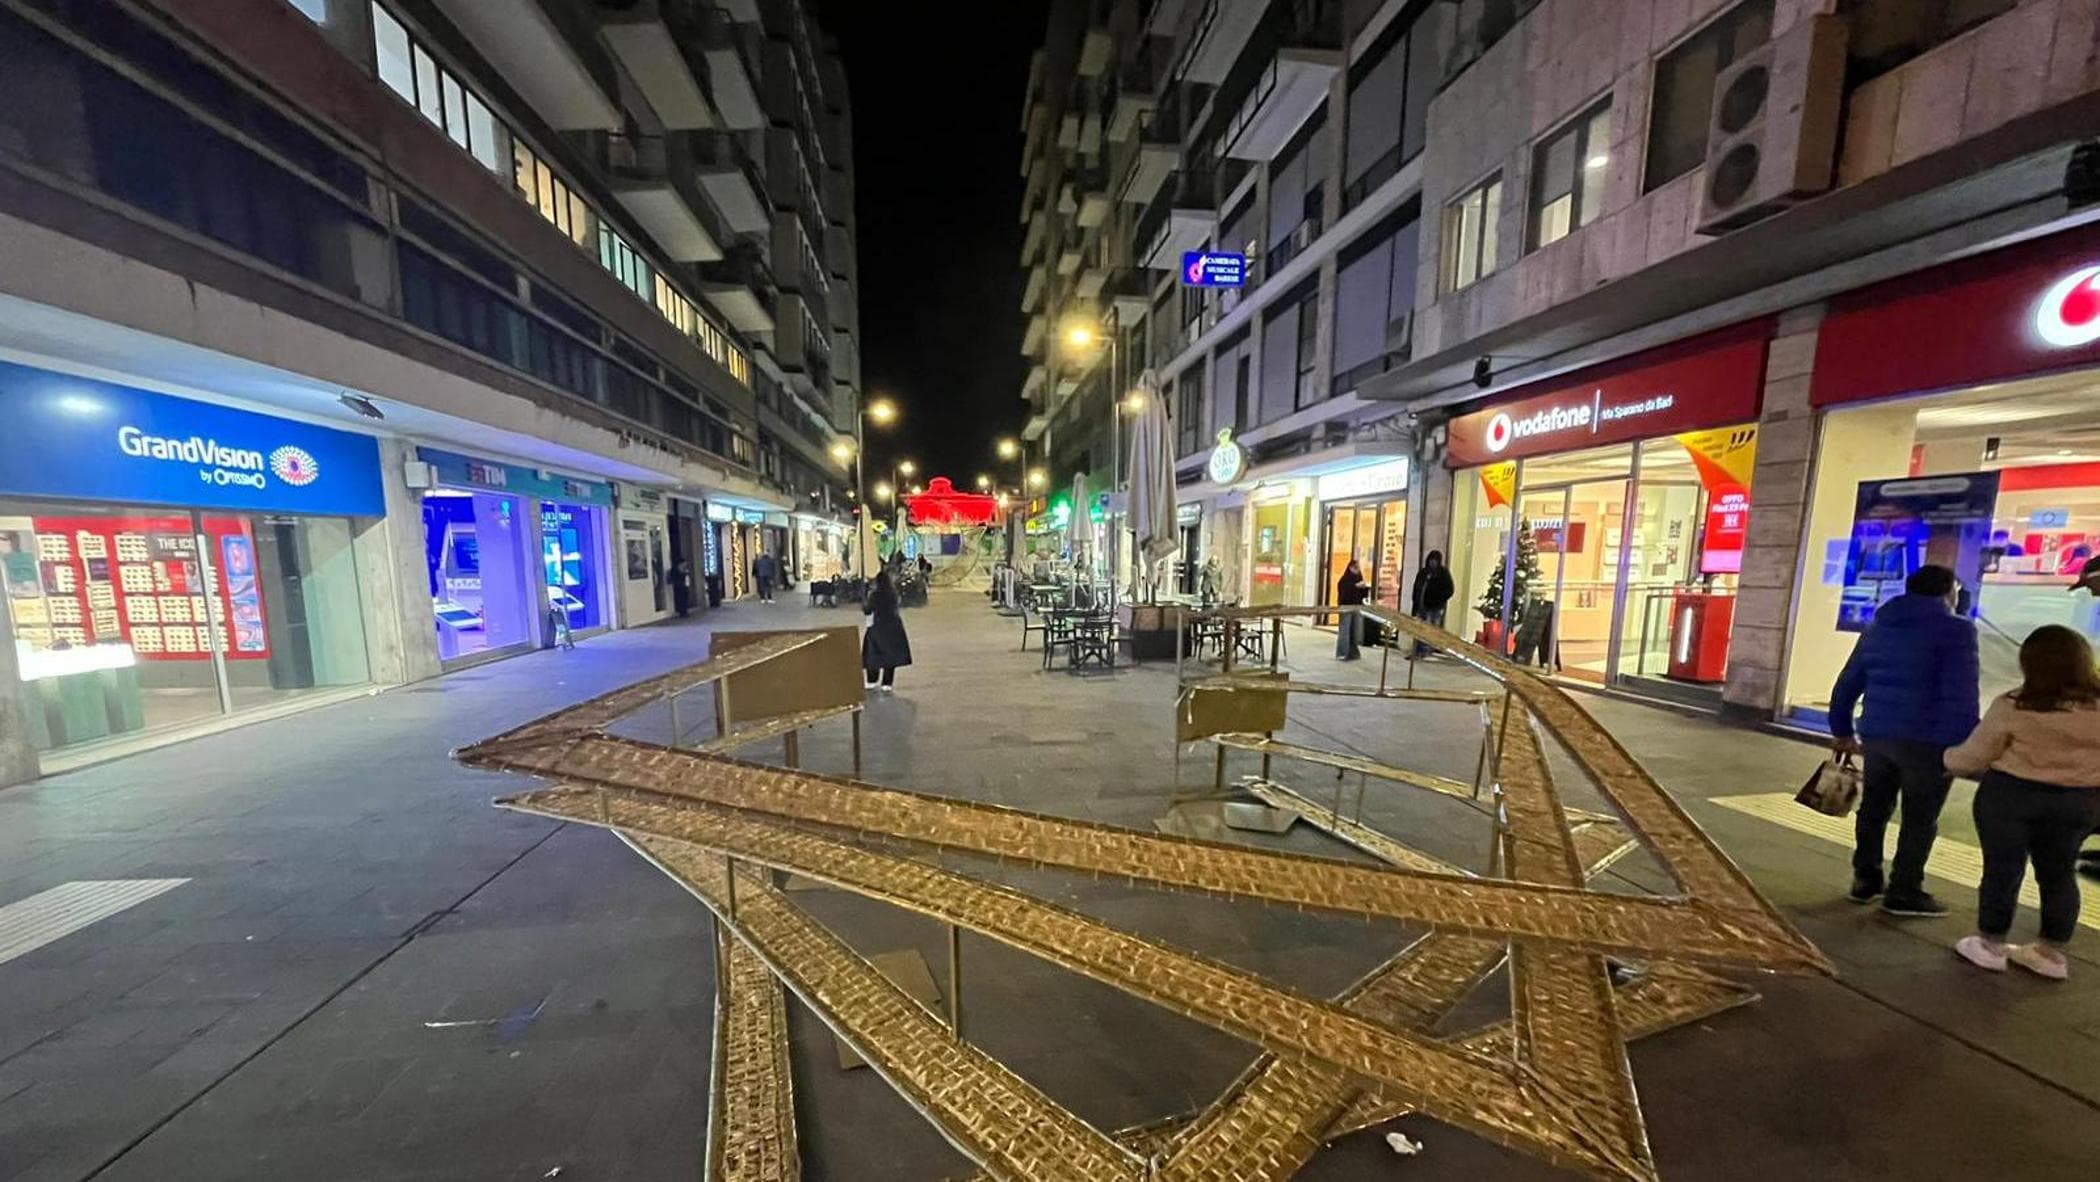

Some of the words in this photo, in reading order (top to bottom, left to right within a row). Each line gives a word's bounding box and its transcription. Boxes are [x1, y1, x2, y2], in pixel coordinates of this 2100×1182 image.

[1206, 266, 1240, 274] MUSICALE
[1513, 405, 1591, 438] vodafone
[118, 425, 265, 471] GrandVision
[199, 469, 213, 484] by
[482, 465, 506, 487] TIM
[157, 538, 178, 549] THE
[178, 538, 196, 550] ICO
